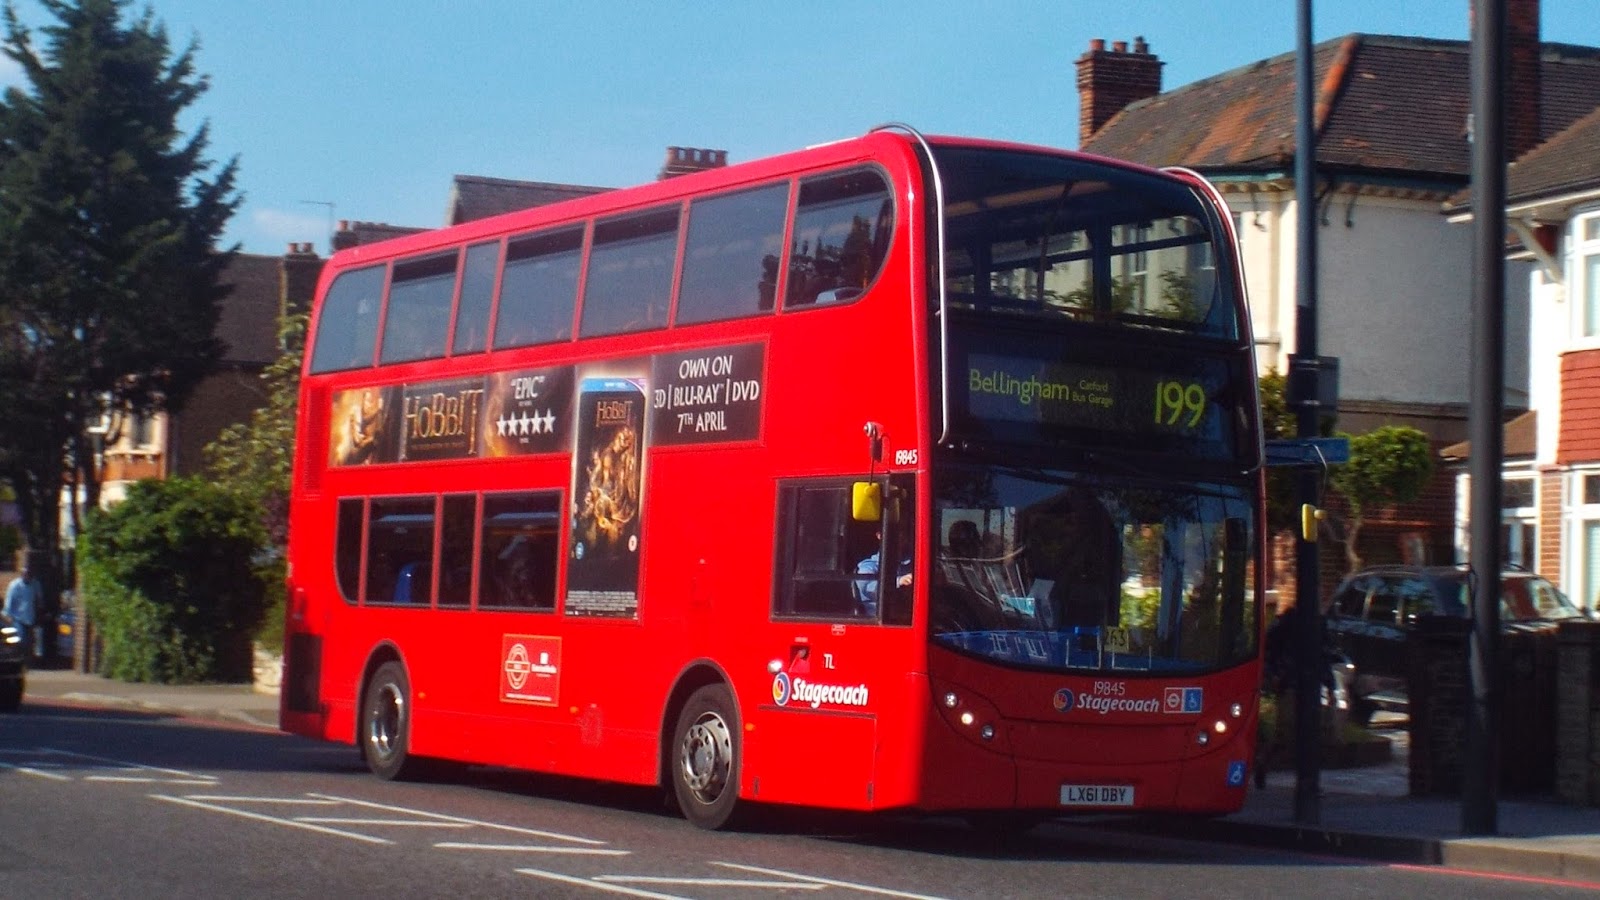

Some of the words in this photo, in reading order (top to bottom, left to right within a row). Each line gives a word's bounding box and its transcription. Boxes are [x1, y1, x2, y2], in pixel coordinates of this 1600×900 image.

[679, 357, 710, 379] OWN
[712, 355, 733, 376] ON
[654, 388, 666, 408] 3D
[732, 380, 759, 402] DVD
[969, 368, 1070, 405] Bellingham
[1079, 379, 1109, 393] Catford
[1072, 391, 1086, 402] Bus
[1088, 393, 1114, 409] Garage
[1155, 381, 1206, 428] 199
[677, 412, 694, 433] 7TH
[695, 410, 727, 432] APRIL
[895, 449, 918, 465] 19845
[823, 653, 835, 669] TL
[791, 677, 869, 708] Stagecoach
[1094, 681, 1126, 696] 19845
[1076, 693, 1160, 714] Stagecoach
[1068, 787, 1098, 802] LX61
[1101, 788, 1126, 802] DBY
